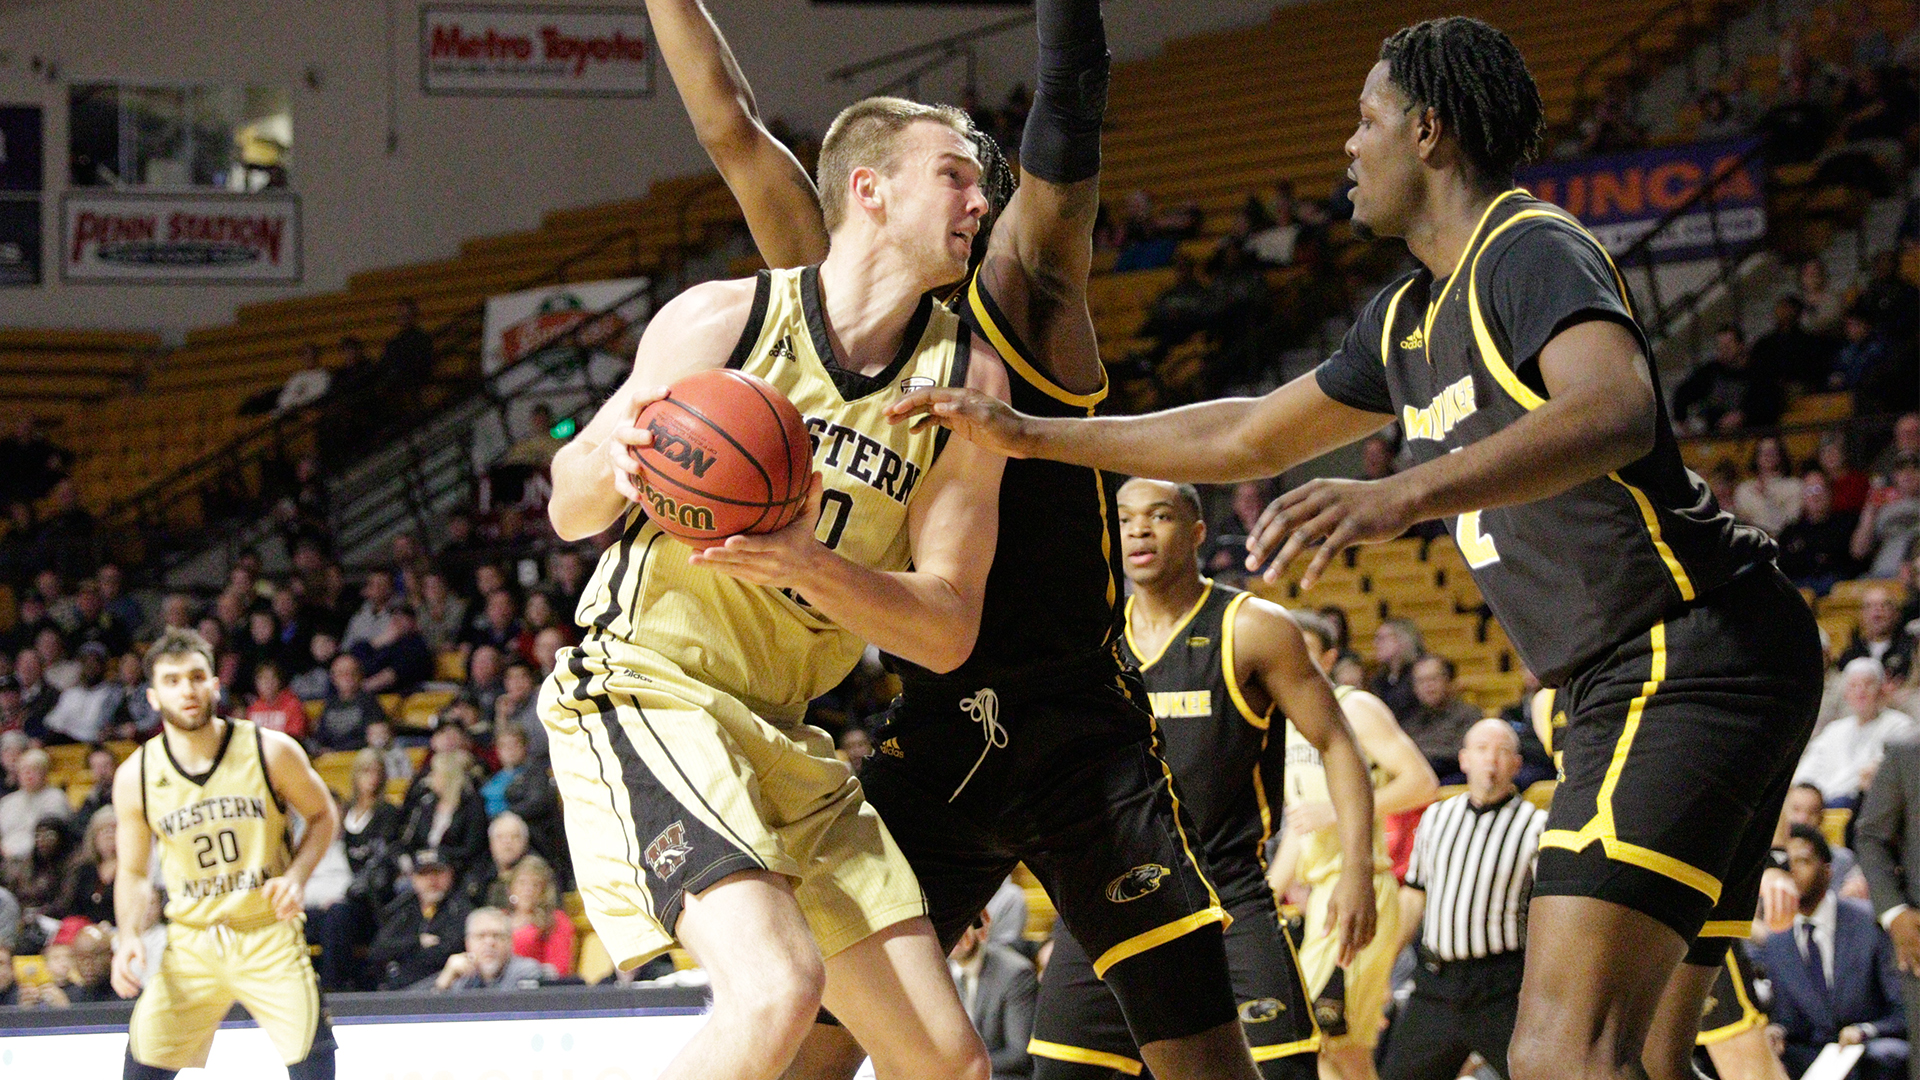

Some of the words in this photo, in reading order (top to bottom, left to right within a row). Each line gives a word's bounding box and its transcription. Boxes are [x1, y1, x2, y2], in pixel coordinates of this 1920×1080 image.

[430, 25, 533, 60] Metro
[539, 25, 645, 77] Toyota
[71, 210, 158, 263] PENN
[167, 211, 285, 265] STATION
[768, 349, 797, 363] adidas
[803, 416, 921, 506] STERN
[630, 473, 717, 531] Wilso
[158, 797, 266, 836] WESTERN
[194, 830, 239, 868] 20
